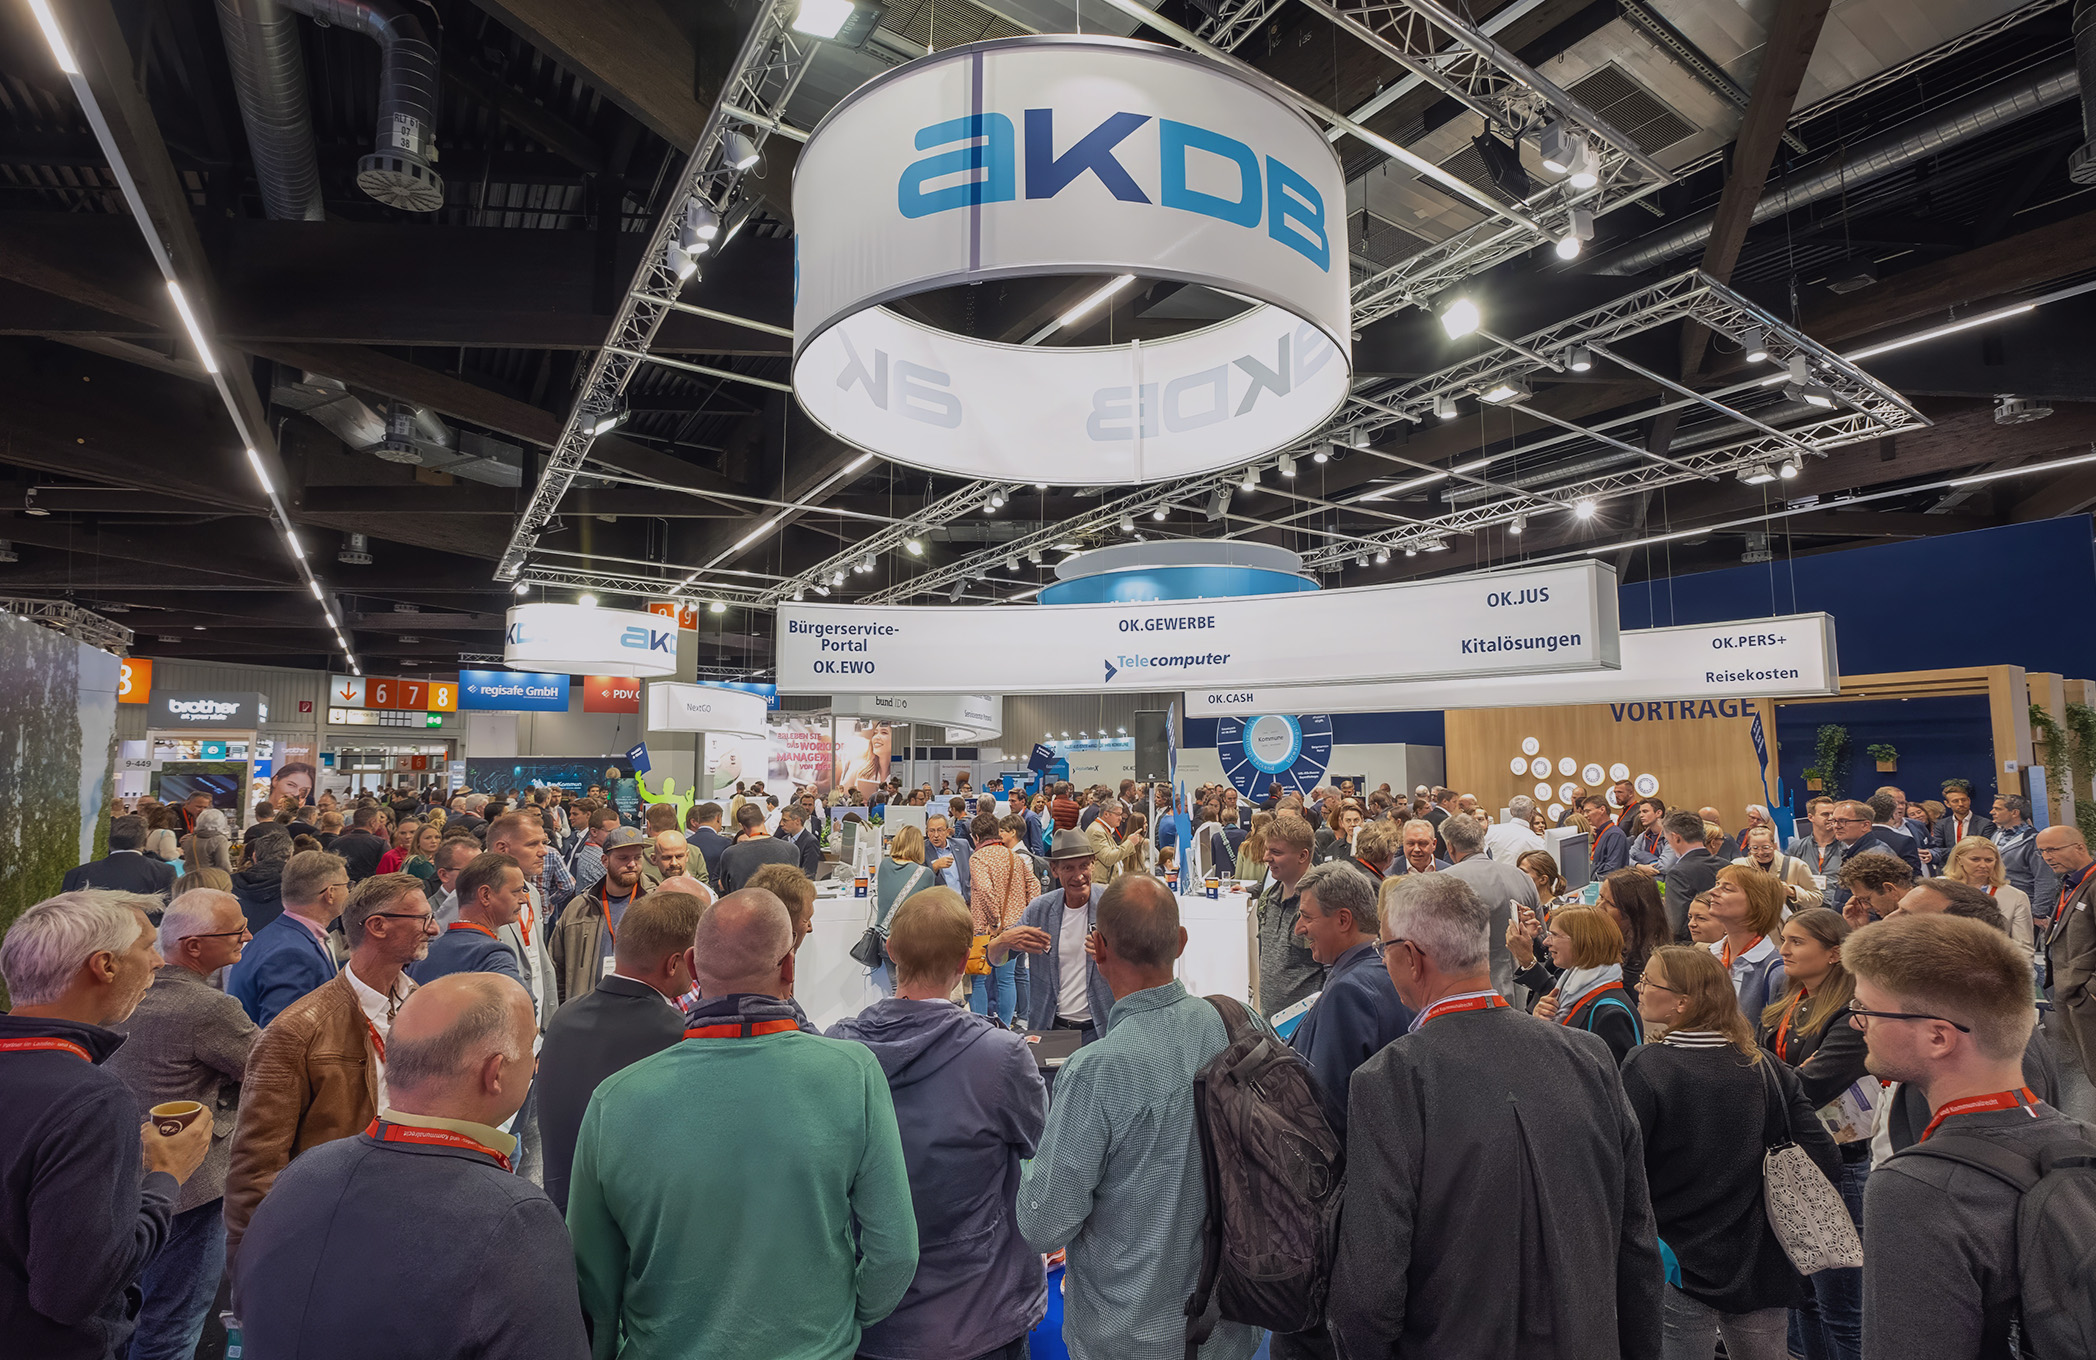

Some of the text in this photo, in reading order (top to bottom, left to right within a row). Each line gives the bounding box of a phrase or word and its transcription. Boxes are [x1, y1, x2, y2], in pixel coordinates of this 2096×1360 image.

[1486, 587, 1550, 608] OK.JUS
[684, 611, 692, 624] 9
[1118, 615, 1216, 633] OK.GEWERBE
[788, 619, 900, 637] Bürgerservice-
[821, 638, 868, 652] Portal
[1460, 631, 1582, 655] Kitalösungen
[1711, 633, 1787, 650] OK.PERS+
[813, 660, 875, 675] OK.EWO
[1117, 651, 1231, 669] Telecomputer
[1705, 666, 1799, 683] Reisekosten
[376, 684, 448, 707] 6 7 8
[480, 684, 559, 698] regisafe GmbH
[613, 689, 634, 699] PDV
[1208, 693, 1254, 704] OK.CASH
[168, 698, 241, 715] brother
[1257, 735, 1284, 743] Kommune
[125, 760, 152, 768] 9-449
